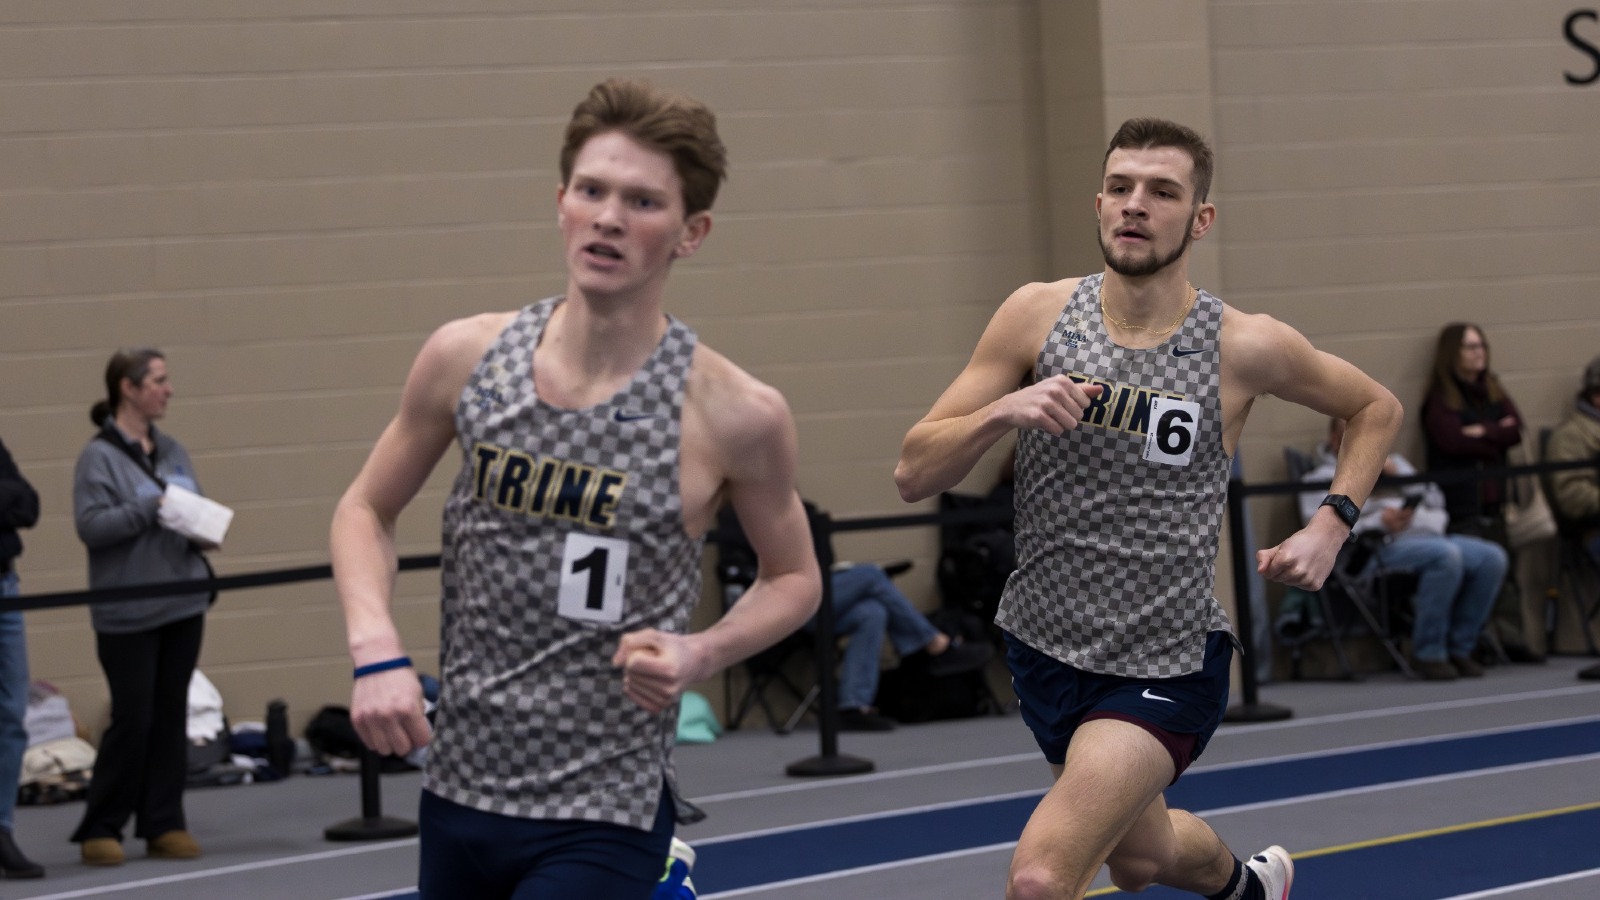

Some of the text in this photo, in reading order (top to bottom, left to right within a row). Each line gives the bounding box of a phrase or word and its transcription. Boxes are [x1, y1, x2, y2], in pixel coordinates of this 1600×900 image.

[1067, 373, 1185, 437] RIN
[1156, 409, 1194, 456] 6
[474, 443, 626, 529] TRINE
[571, 546, 610, 611] 1
